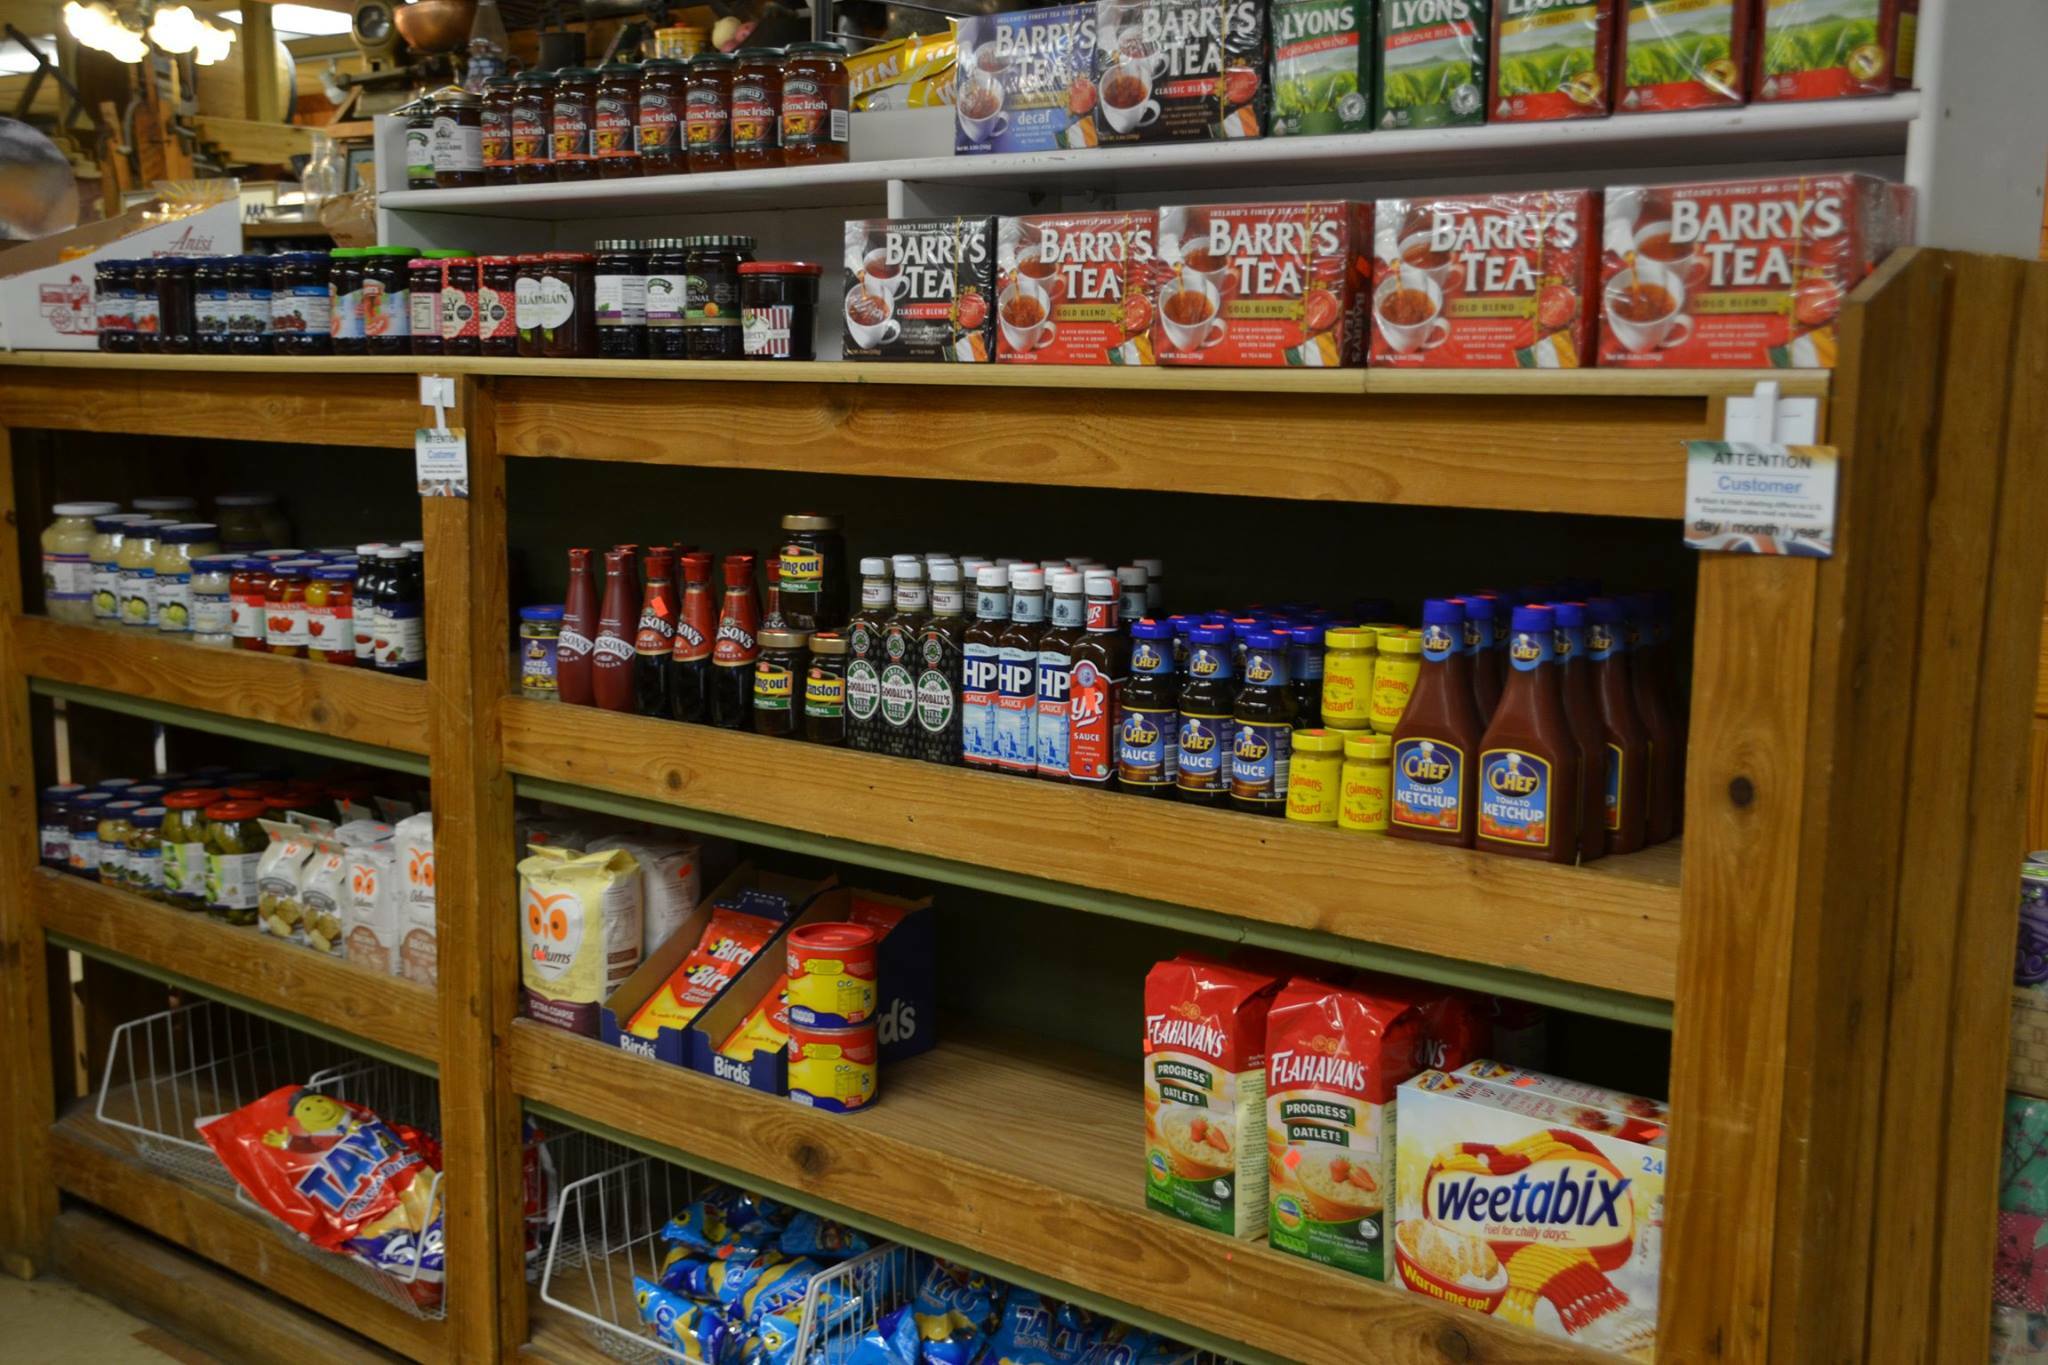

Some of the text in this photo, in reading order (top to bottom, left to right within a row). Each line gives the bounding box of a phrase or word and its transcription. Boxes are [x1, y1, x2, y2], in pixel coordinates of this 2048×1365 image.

[1141, 1, 1256, 43] BARRY'S
[1282, 5, 1355, 40] LYONS
[1391, 0, 1470, 29] LYONS
[995, 15, 1096, 58] BARRY'S
[1164, 42, 1222, 77] TEA
[1154, 85, 1185, 96] CLASSIC
[1017, 110, 1051, 125] decaf
[1668, 191, 1843, 244] BARRY'S
[1208, 214, 1340, 257] BARRY'S
[1430, 211, 1578, 253] BARRY'S
[885, 228, 987, 266] BARRY'S
[1040, 224, 1154, 264] BARRY'S
[1459, 252, 1537, 292] TEA
[1704, 243, 1794, 286] TEA
[905, 265, 956, 299] TEA
[1062, 264, 1121, 299] TEA
[1234, 257, 1301, 295] TEA
[1227, 305, 1284, 314] GOLD BLEND
[1451, 302, 1515, 312] GOLD BLEND
[1730, 297, 1768, 307] BLEND
[896, 308, 948, 316] CLASSIC BLEND
[1056, 308, 1106, 317] GOLD BLEND
[1712, 452, 1812, 469] ATTENTION
[1717, 475, 1803, 494] Customer
[1694, 518, 1720, 535] day
[1732, 521, 1779, 536] month
[1791, 527, 1823, 541] year
[799, 559, 819, 573] out
[1423, 636, 1450, 650] CHEF
[1133, 653, 1160, 668] CHEF
[1511, 645, 1540, 659] CHEF
[851, 661, 870, 673] IRISH
[886, 668, 905, 678] IRISH
[963, 660, 998, 689] HP
[1190, 659, 1218, 674] CHEF
[1247, 666, 1273, 680] CHEF
[769, 677, 788, 690] out
[923, 673, 942, 683] IRISH
[998, 663, 1032, 694] HP
[1039, 667, 1070, 699] HP
[1375, 676, 1409, 694] Colman's
[847, 681, 878, 695] GOODALL'S
[881, 686, 914, 700] GOODALL'S
[855, 697, 870, 706] STEAK
[888, 703, 905, 711] STEAK
[917, 692, 951, 706] GOODALL'S
[965, 694, 988, 704] SAUCE
[1000, 698, 1022, 708] SAUCE
[855, 705, 870, 713] SAUCE
[888, 710, 905, 719] SAUCE
[924, 709, 941, 718] STEAK
[1040, 703, 1062, 714] SAUCE
[924, 716, 941, 725] SAUCE
[1073, 732, 1100, 743] SAUCE
[1123, 726, 1158, 743] CHEF
[1180, 731, 1214, 750] CHEF
[1121, 749, 1156, 762] SAUCE
[1233, 739, 1267, 759] CHEF
[1179, 754, 1213, 769] SAUCE
[1232, 762, 1265, 777] SAUCE
[1405, 756, 1451, 780] CHEF
[1409, 783, 1444, 794] TOMATO
[1490, 768, 1536, 794] CHEF
[1346, 783, 1383, 800] Colman's
[1397, 788, 1457, 809] KETCHUP
[1496, 796, 1531, 808] TOMATO
[1344, 807, 1383, 823] Mustard
[1483, 802, 1545, 823] KETCHUP
[1146, 1014, 1227, 1058] FLAHAVAN'S
[620, 1035, 655, 1060] Bird's
[714, 1056, 750, 1085] Bird's
[1158, 1064, 1209, 1084] PROGRESS
[1271, 1050, 1367, 1091] FLAHAVAN'S
[1163, 1087, 1200, 1104] OATLETS
[1286, 1103, 1348, 1120] PROGRESS
[1293, 1127, 1341, 1143] OATLETS
[1642, 1156, 1664, 1175] 24
[1437, 1167, 1632, 1228] Weetabix
[1484, 1223, 1500, 1235] Fuel
[1502, 1226, 1513, 1235] for
[1515, 1227, 1539, 1240] chilly
[1402, 1260, 1491, 1312] Warm me up!
